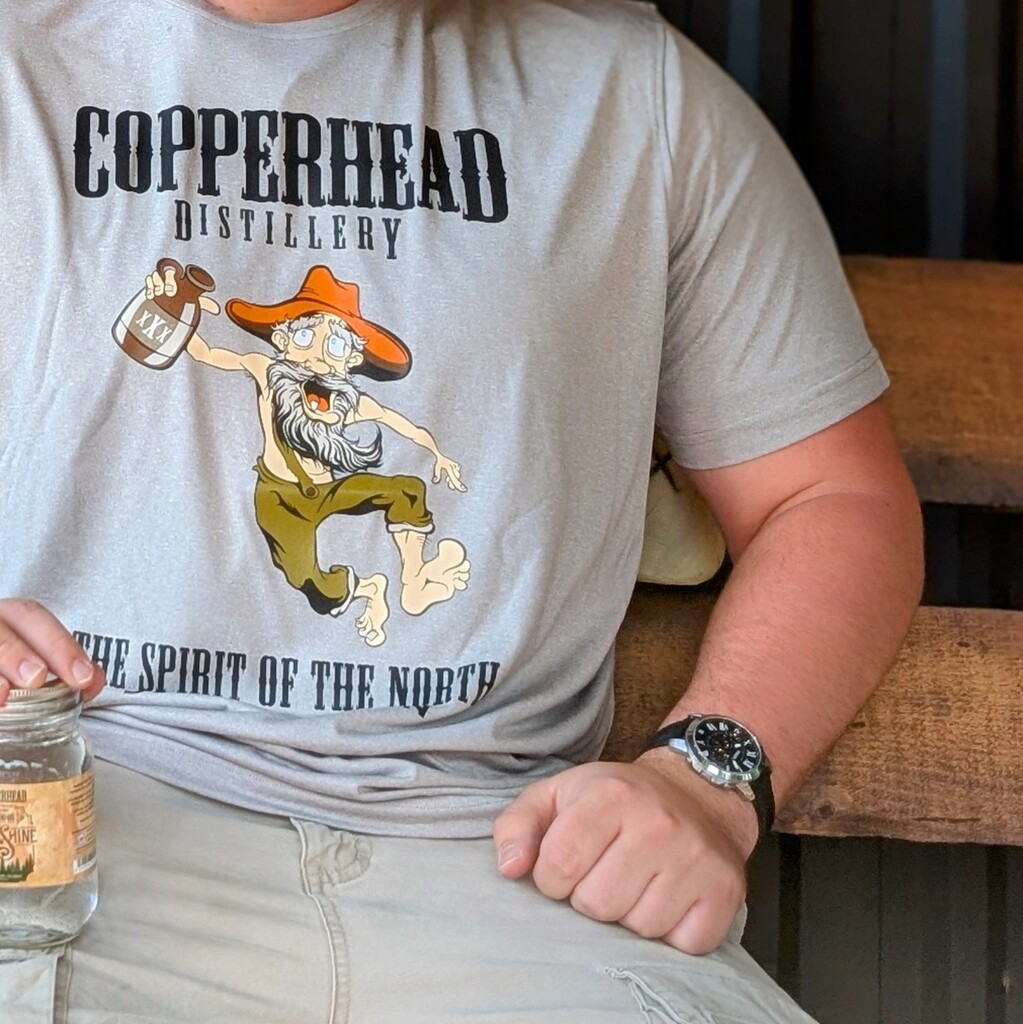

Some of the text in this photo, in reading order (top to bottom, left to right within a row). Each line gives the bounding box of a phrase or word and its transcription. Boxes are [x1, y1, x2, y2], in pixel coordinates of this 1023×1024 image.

[73, 104, 509, 224] COPPERHEAD
[174, 199, 402, 260] DISTILLERY
[136, 309, 173, 344] XXX
[137, 642, 247, 702] SPIRIT
[258, 655, 299, 708] OF
[310, 660, 375, 712] THE
[388, 661, 501, 718] NORTH
